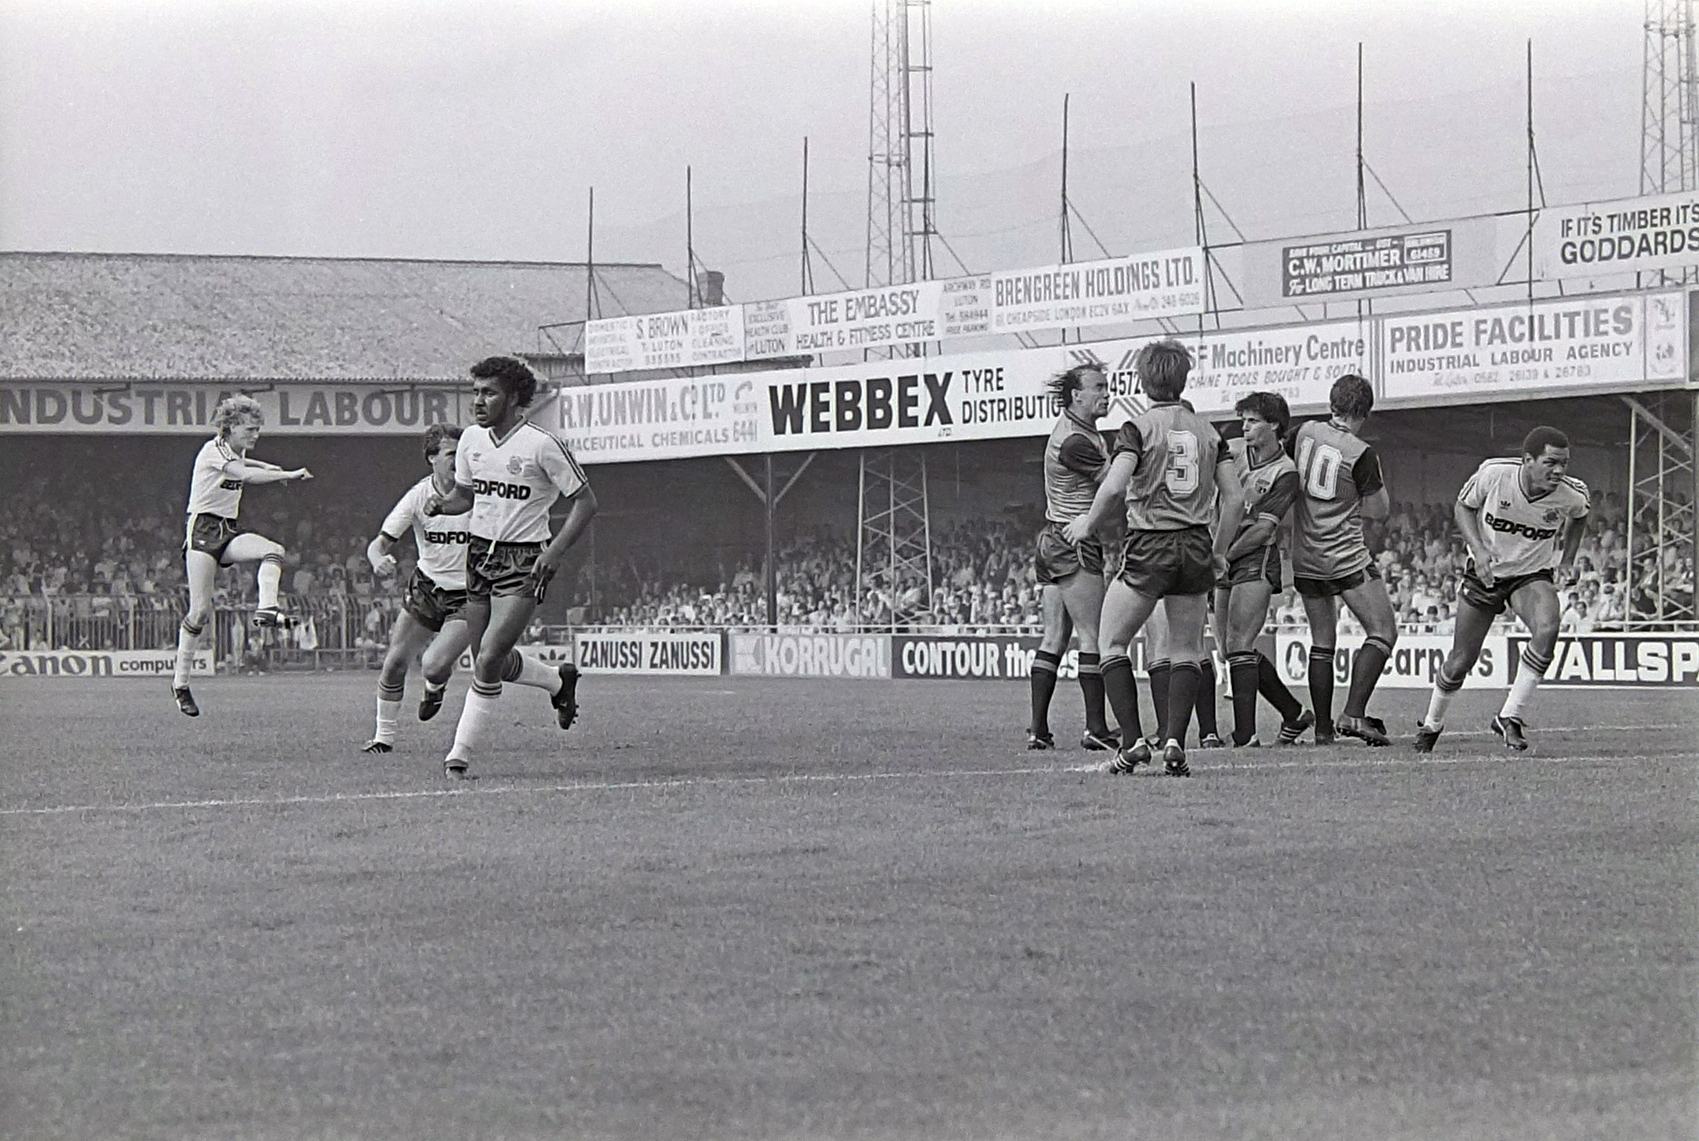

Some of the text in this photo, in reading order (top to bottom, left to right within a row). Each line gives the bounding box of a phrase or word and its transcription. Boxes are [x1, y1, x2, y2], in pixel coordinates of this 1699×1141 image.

[1561, 219, 1573, 238] IF
[1607, 207, 1671, 233] TIMBER
[1561, 227, 1699, 265] GODDARDS
[995, 256, 1199, 307] BRENGREEN HOLDINGS LTD.
[1305, 275, 1333, 293] LONG
[1334, 272, 1363, 289] TERM
[808, 289, 919, 326] THE EMBASSY
[648, 314, 689, 340] BROWN
[691, 335, 735, 349] CLEANING
[796, 319, 936, 351] HEALTH & FITNESS CENTRE
[1390, 305, 1633, 353] PRIDE FACILITIES
[652, 340, 683, 353] LUTON
[755, 338, 786, 355] LUTON
[1212, 341, 1302, 370] Machinery
[1306, 334, 1365, 362] Centre
[1390, 341, 1633, 374] INDUSTRIAL LABOUR AGENCY
[1226, 369, 1258, 387] TOOLS
[1263, 365, 1308, 385] BOUGHT
[278, 390, 449, 427] LABOUR
[768, 367, 1005, 436] WEBBEX TYRE
[651, 427, 729, 448] CHEMICALS
[1166, 431, 1199, 494] 3
[1298, 436, 1343, 500] 10
[1484, 511, 1557, 541] BEDFORD
[119, 657, 207, 673] compurs
[580, 640, 715, 669] ZANUSSI ZANUSSI
[764, 636, 888, 676] KORRUGAL
[902, 641, 1000, 677] CONTOUR
